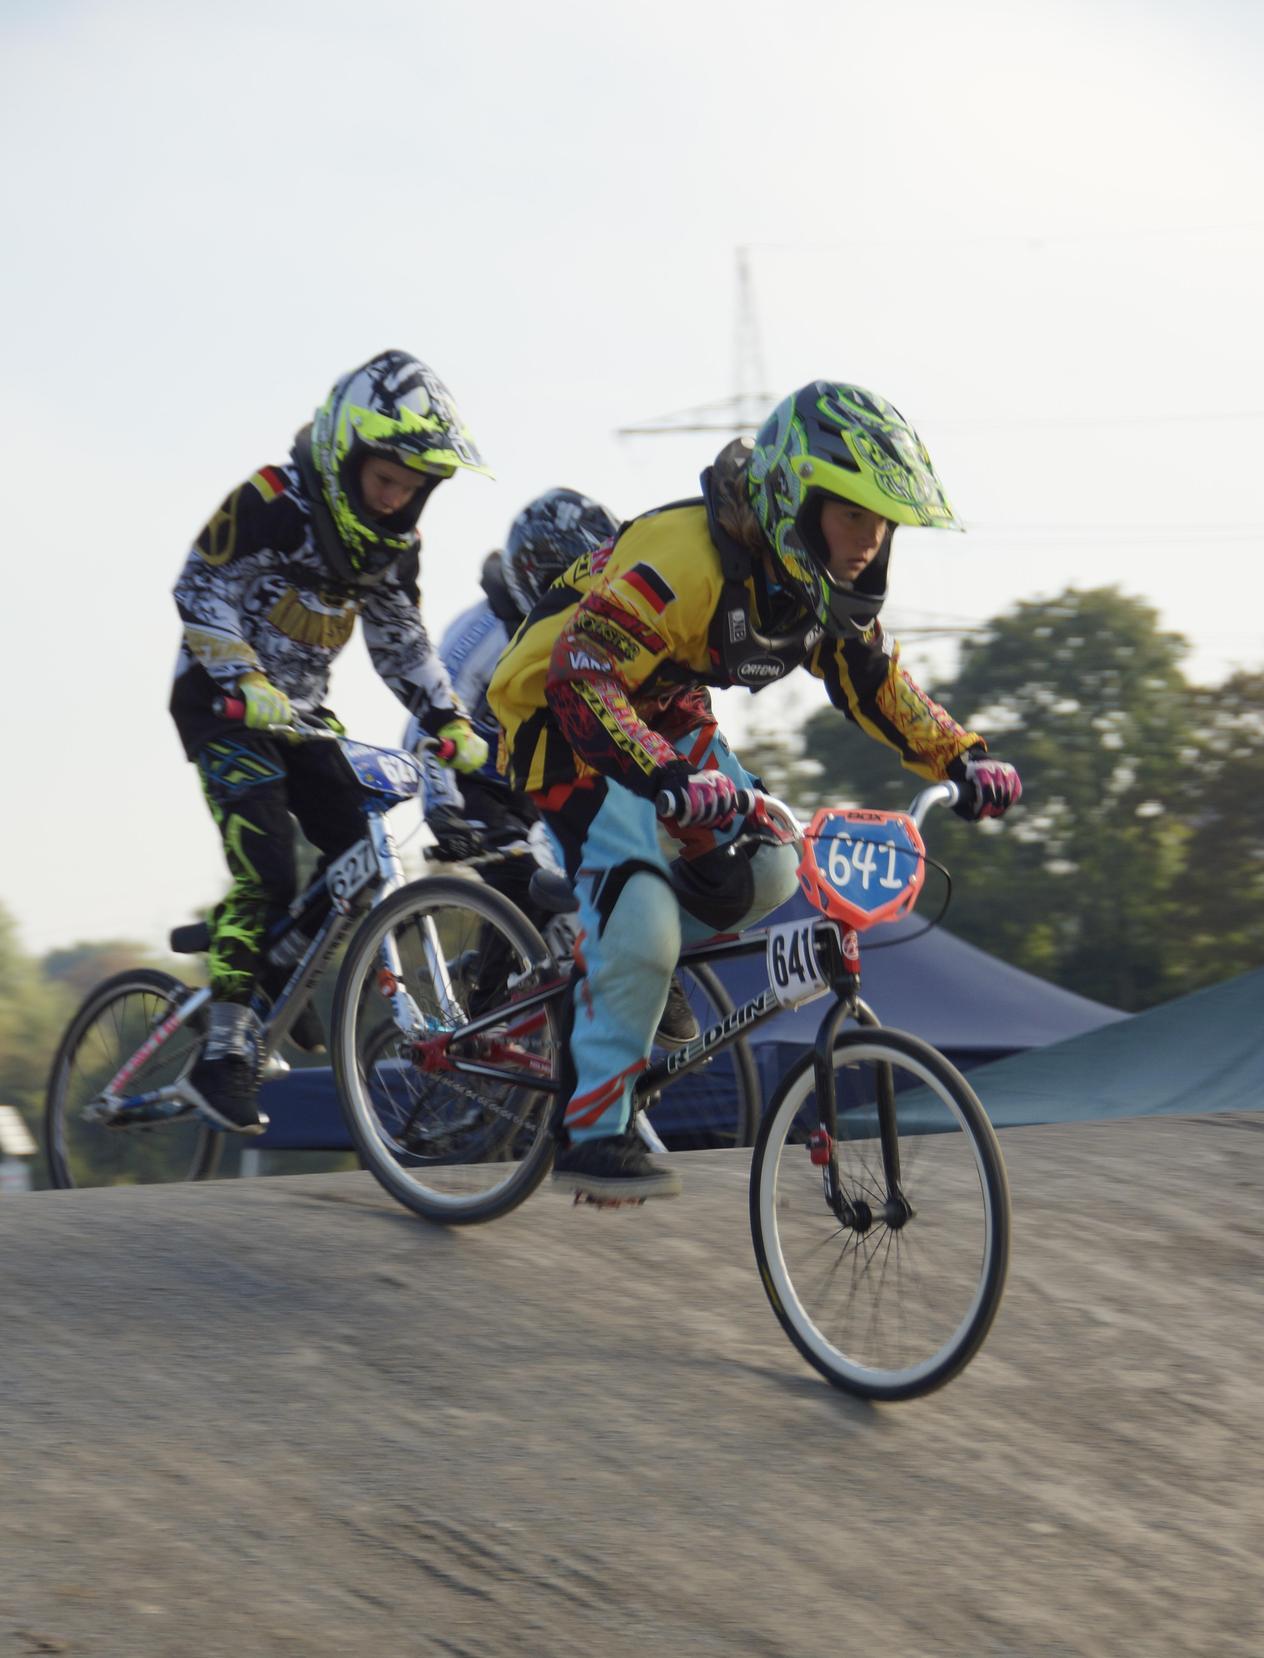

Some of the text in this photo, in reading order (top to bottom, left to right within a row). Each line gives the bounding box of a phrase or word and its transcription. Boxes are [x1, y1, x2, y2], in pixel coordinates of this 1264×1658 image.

[740, 662, 780, 677] ORTEMA
[332, 844, 370, 898] 627
[828, 832, 902, 890] 641
[773, 927, 818, 987] 641
